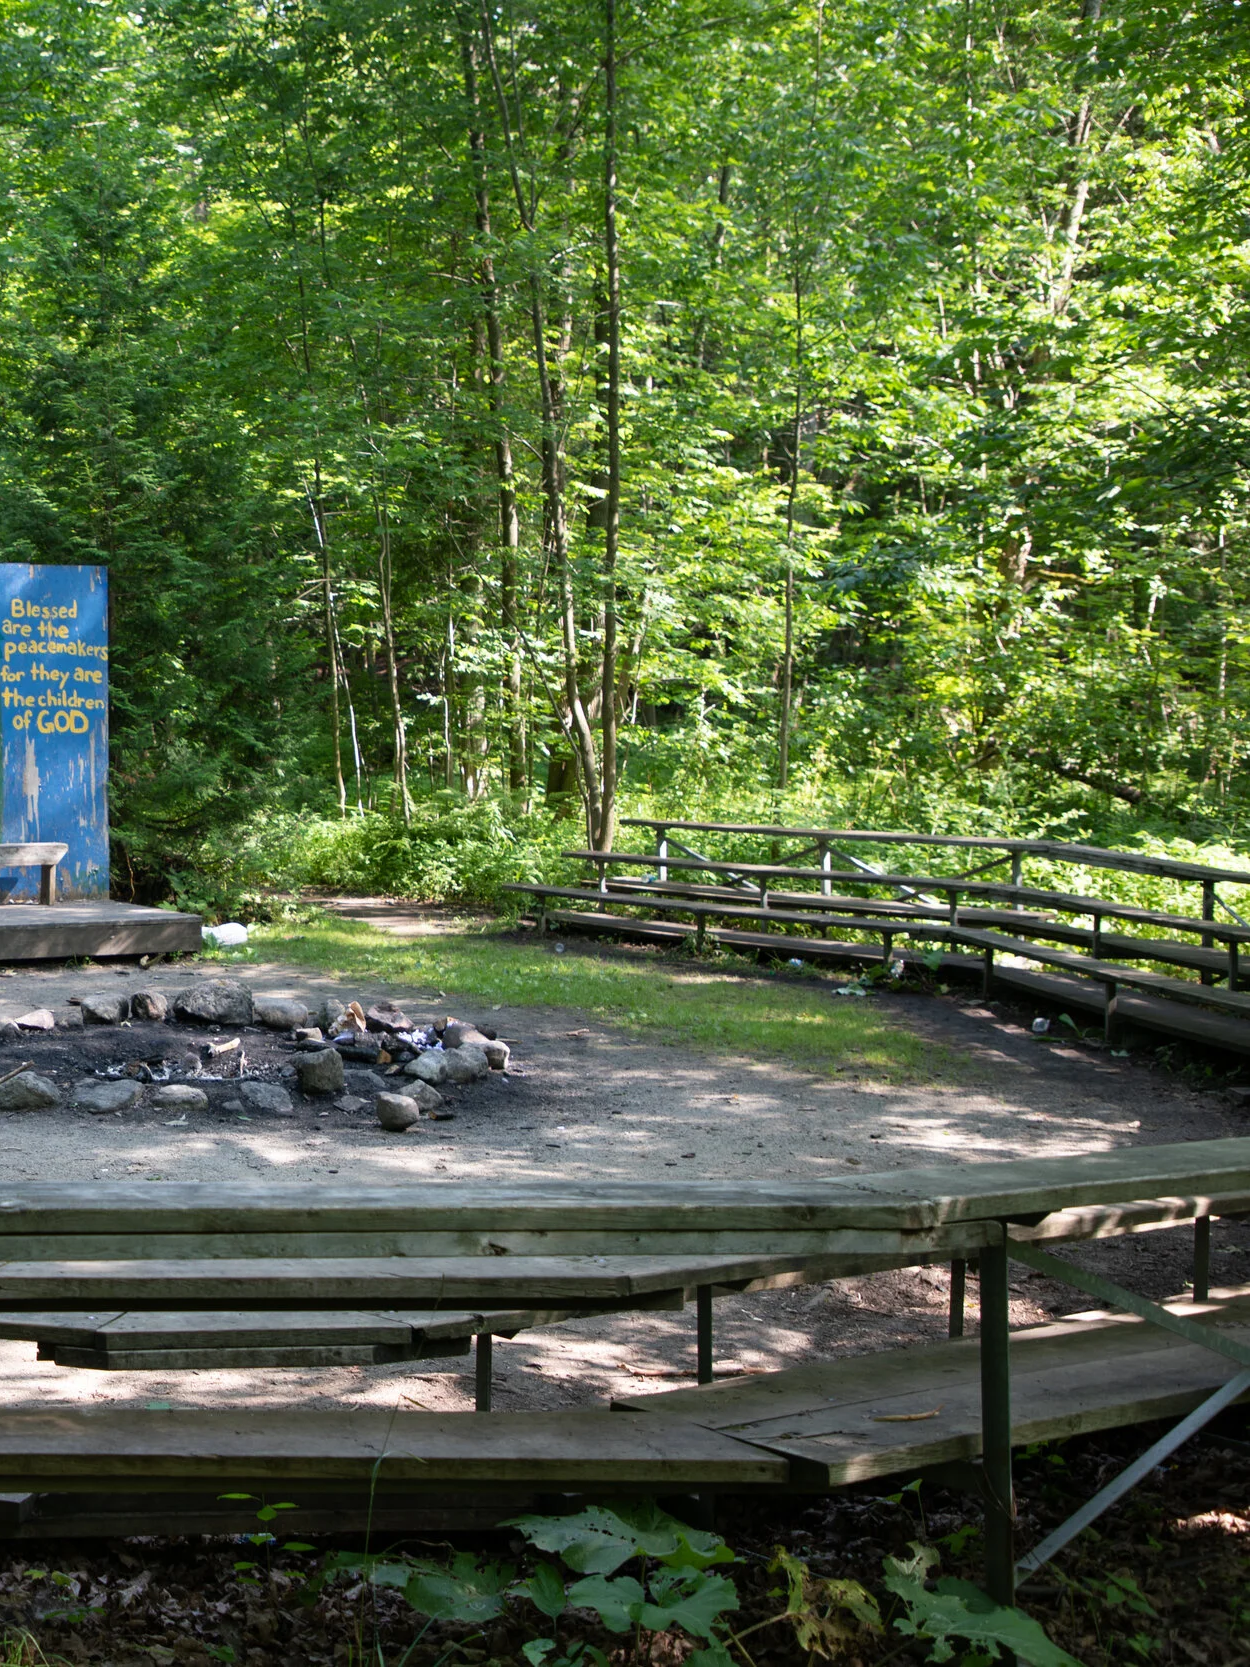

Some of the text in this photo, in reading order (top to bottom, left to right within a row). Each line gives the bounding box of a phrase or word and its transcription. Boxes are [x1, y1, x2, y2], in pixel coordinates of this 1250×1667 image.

[11, 598, 78, 619] Blessed
[2, 619, 69, 639] are the
[4, 639, 109, 662] peacemakers
[0, 662, 103, 690] for they are
[1, 686, 105, 710] the children
[12, 709, 90, 734] of GOD
